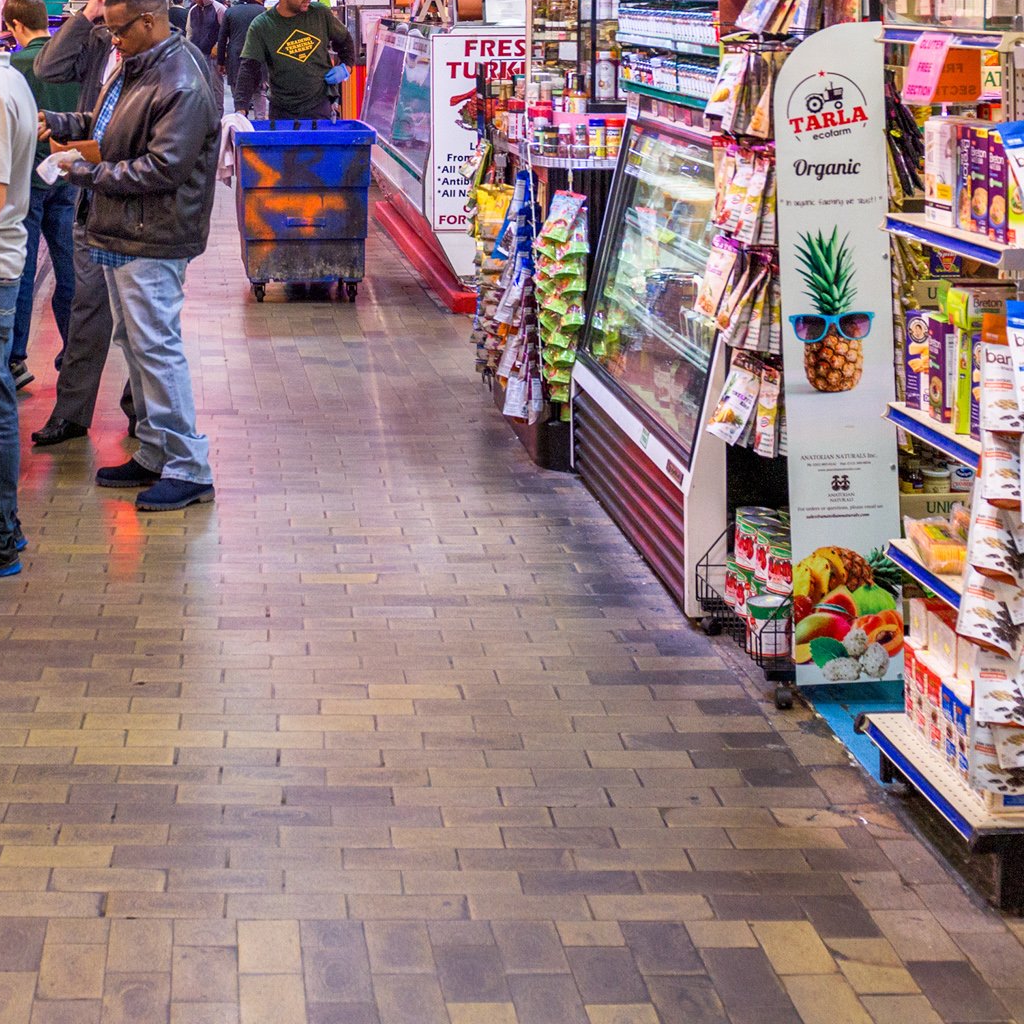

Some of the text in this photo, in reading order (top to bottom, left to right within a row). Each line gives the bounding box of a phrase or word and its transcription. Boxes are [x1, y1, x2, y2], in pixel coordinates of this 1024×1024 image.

[463, 39, 526, 58] FRES
[788, 106, 869, 135] TARLA
[812, 127, 852, 141] ecofarm
[792, 158, 862, 181] Organic
[438, 215, 466, 225] FOR
